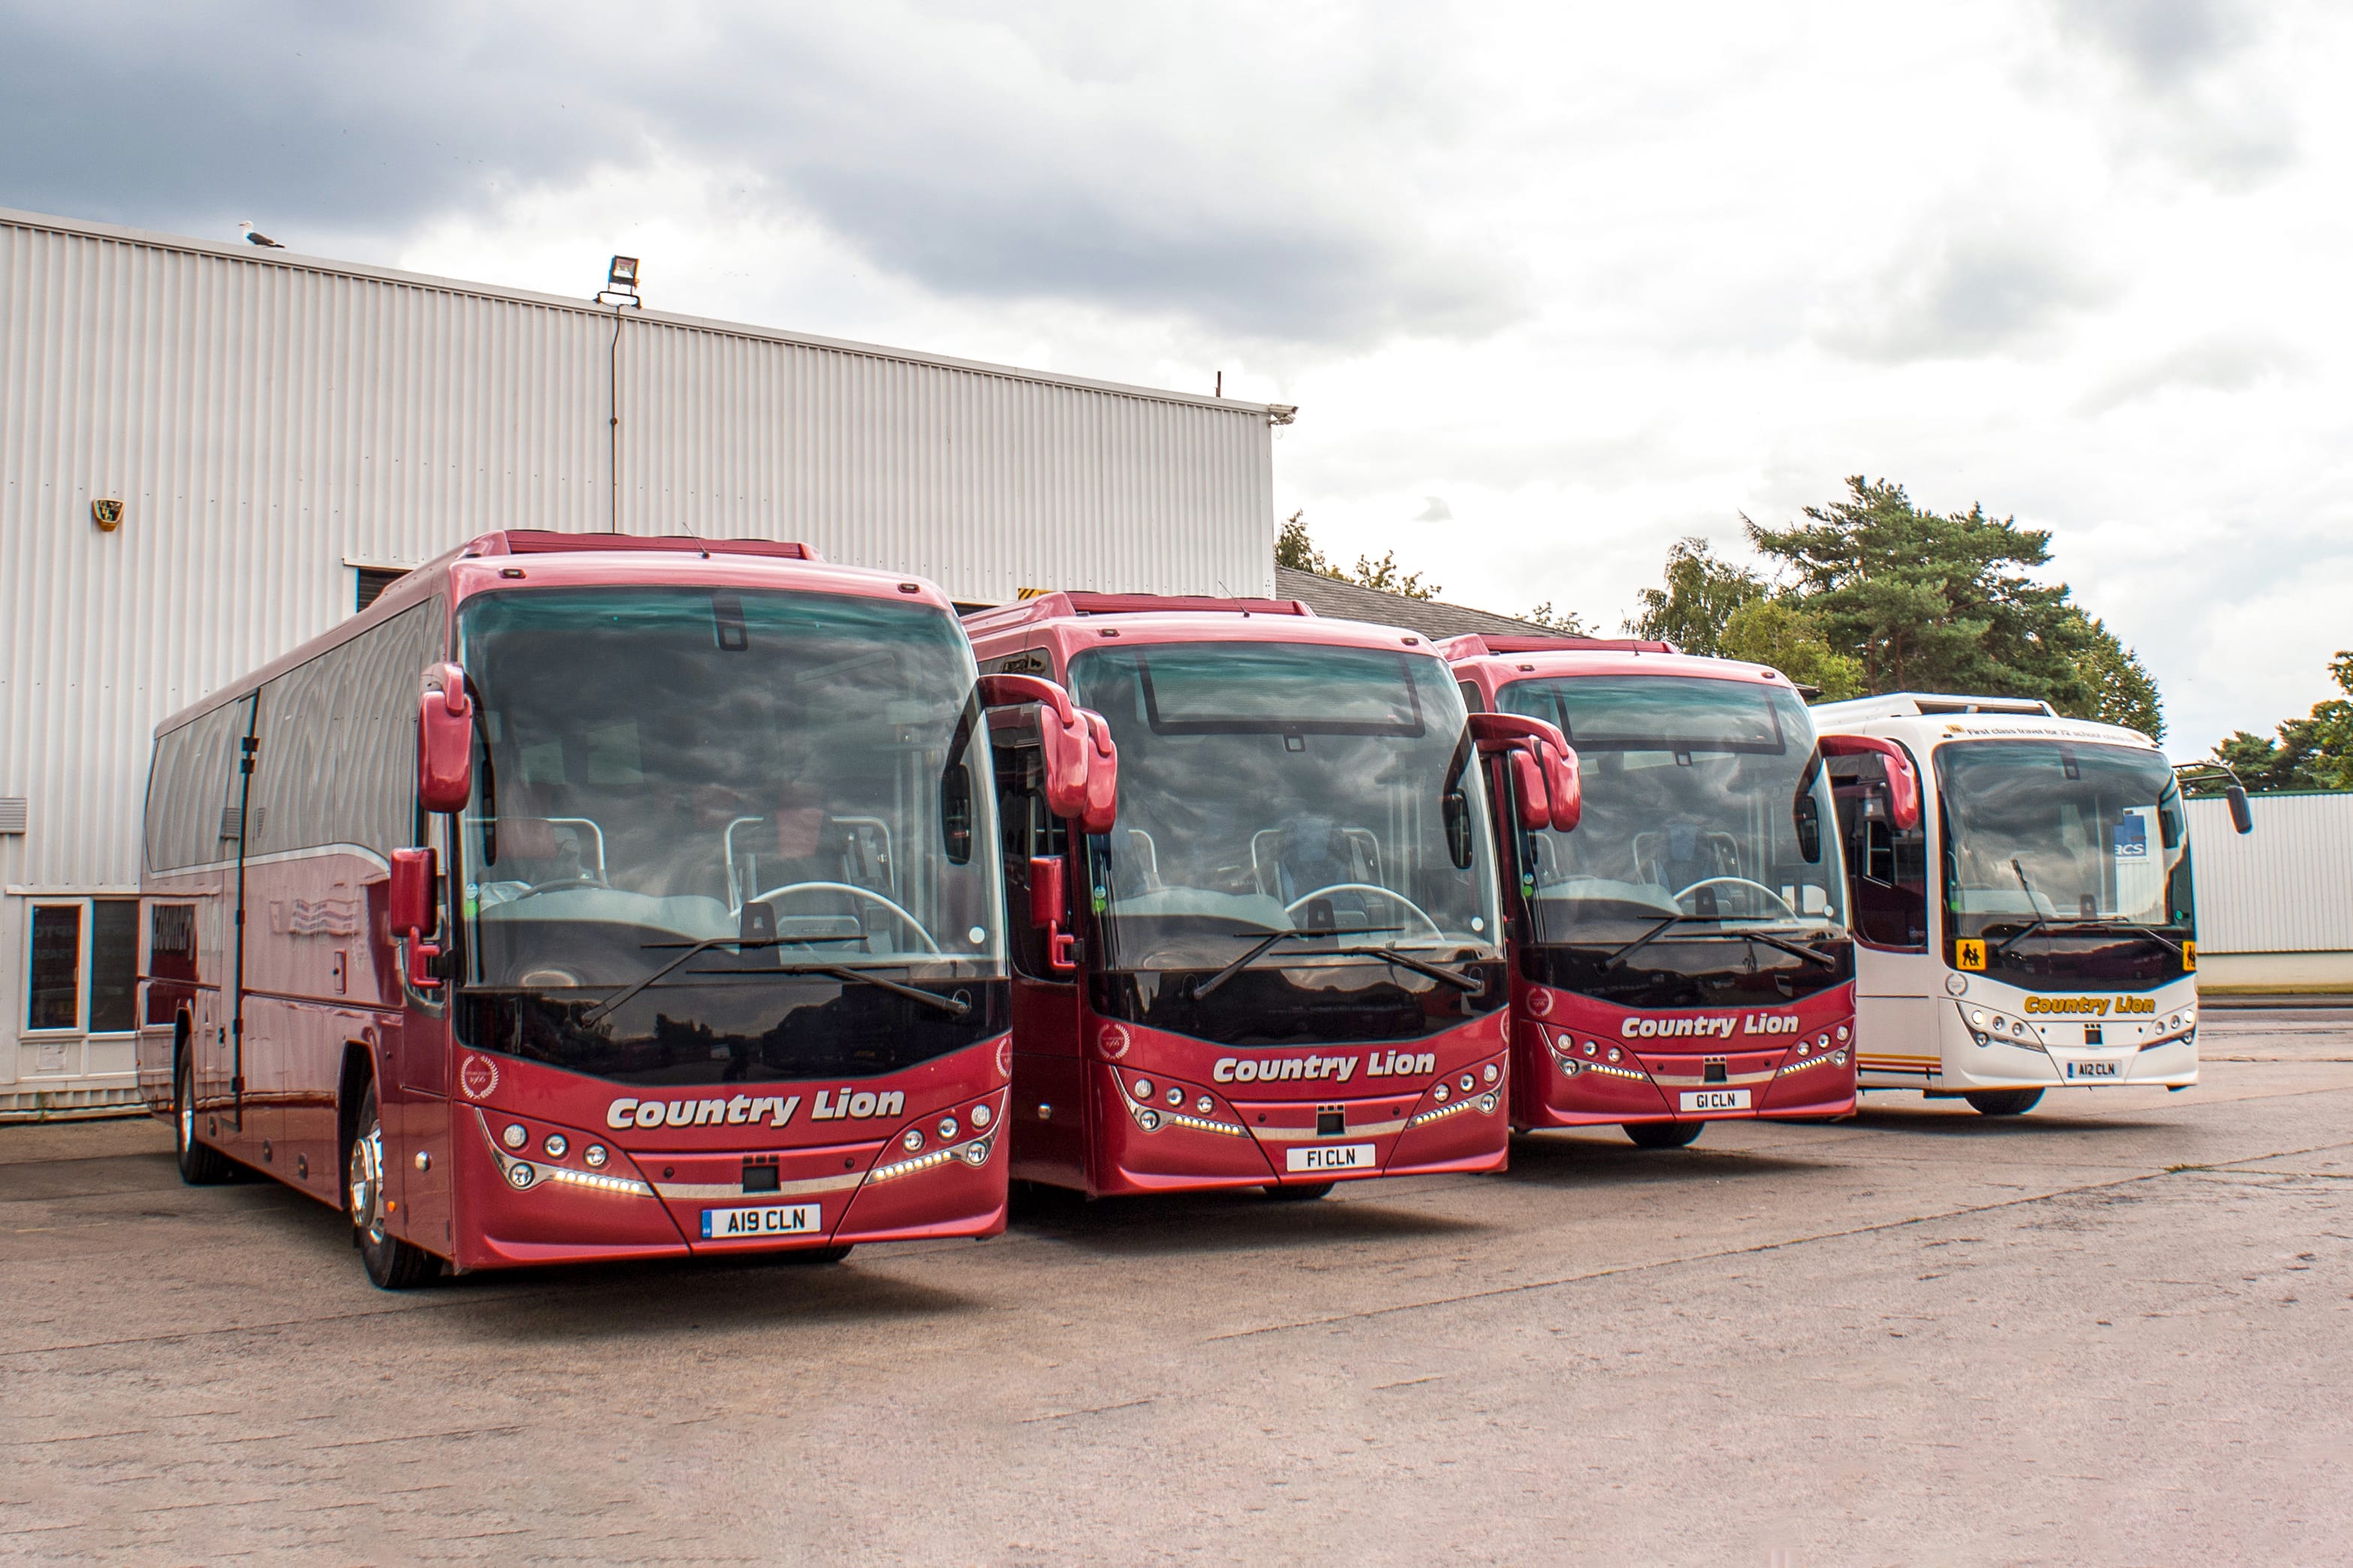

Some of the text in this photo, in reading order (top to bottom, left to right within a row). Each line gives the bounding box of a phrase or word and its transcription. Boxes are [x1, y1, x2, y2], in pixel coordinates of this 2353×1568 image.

[2024, 995, 2155, 1016] Country Lion
[1621, 1012, 1800, 1039] Country Lion
[1213, 1050, 1436, 1084] Country Lion
[2079, 1063, 2115, 1075] A12 CLN
[606, 1087, 906, 1129] Country Lion
[1696, 1093, 1736, 1108] G1 CLN
[1307, 1148, 1356, 1167] F1 CLN
[727, 1208, 805, 1232] A19 CLN
